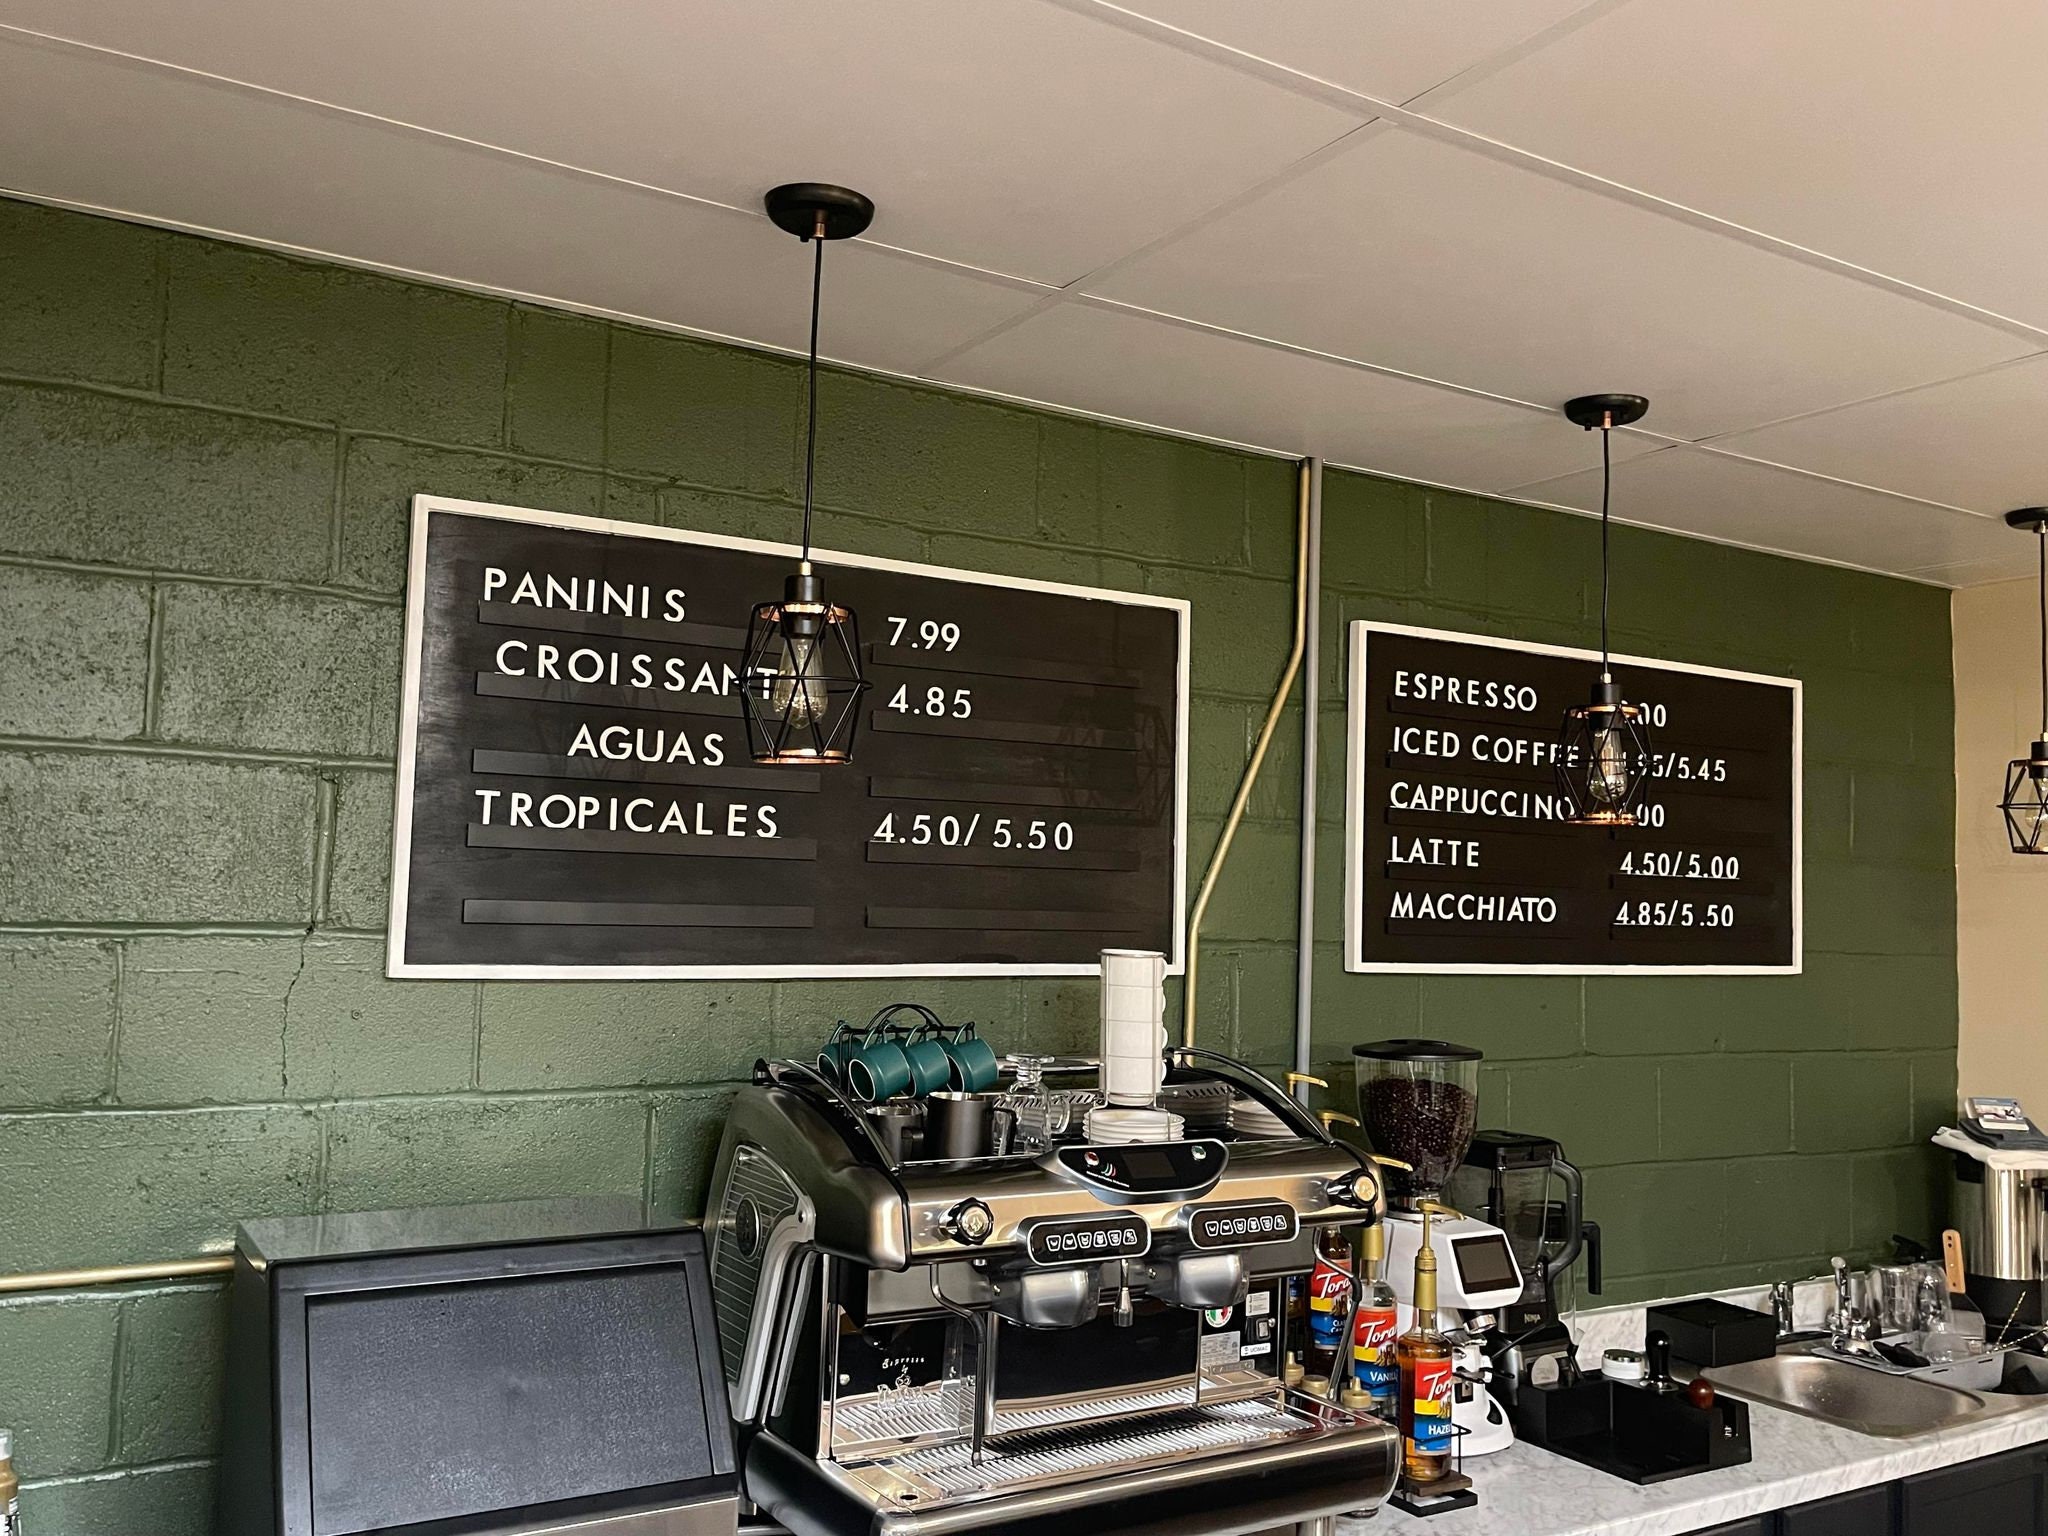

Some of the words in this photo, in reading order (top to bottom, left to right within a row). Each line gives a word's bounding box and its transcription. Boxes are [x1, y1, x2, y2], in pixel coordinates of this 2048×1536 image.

[485, 567, 686, 623] PANINIS
[887, 616, 960, 652] 7.99
[496, 640, 778, 700] CROISSANT
[887, 683, 972, 719] 4.85
[1395, 670, 1537, 712] ESPRESSO
[567, 723, 725, 766] AGUAS
[1393, 726, 1460, 758] ICED
[1471, 734, 1579, 768] COFFEE
[1620, 750, 1726, 782] .95/5.45
[475, 789, 779, 839] TROPICALES
[1389, 781, 1575, 821] CAPPUCCINO
[1391, 836, 1480, 867] LATTE
[1390, 891, 1557, 923] MACCHIATO
[1316, 1272, 1351, 1299] Tora
[1360, 1320, 1397, 1350] Tora
